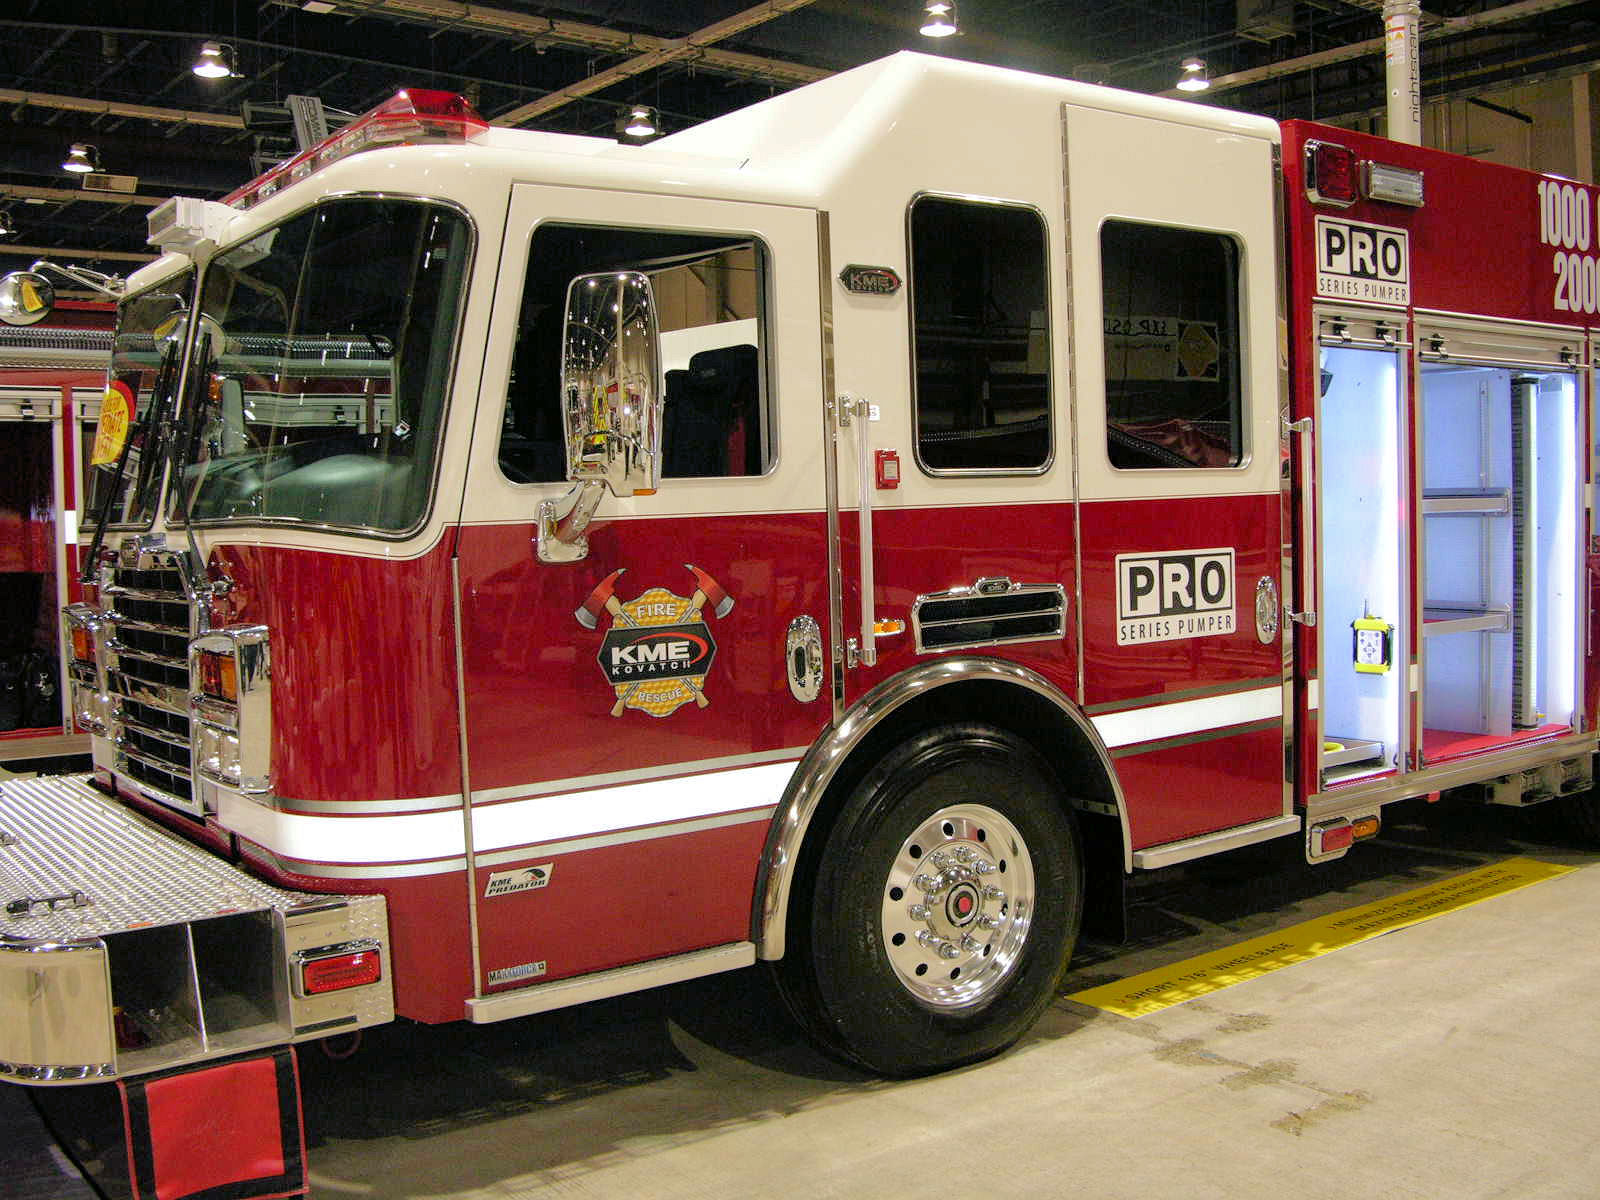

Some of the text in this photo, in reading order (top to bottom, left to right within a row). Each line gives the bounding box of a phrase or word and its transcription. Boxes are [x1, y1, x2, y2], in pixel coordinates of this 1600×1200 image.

[1408, 23, 1420, 123] nightscan
[1537, 180, 1590, 252] 1000
[1326, 227, 1401, 276] PRO
[1320, 278, 1407, 302] SERIES PUMPER
[1129, 560, 1226, 611] PRO
[636, 603, 677, 618] FIRE
[1121, 614, 1232, 641] SERIES PUMPER
[611, 640, 690, 665] KME
[611, 660, 691, 675] KOVATCH
[639, 687, 683, 703] RESCUE
[488, 879, 545, 895] PREDATOR
[491, 877, 512, 887] KME
[1126, 981, 1176, 1001] SHORT
[1211, 942, 1295, 971] WHEELBASE
